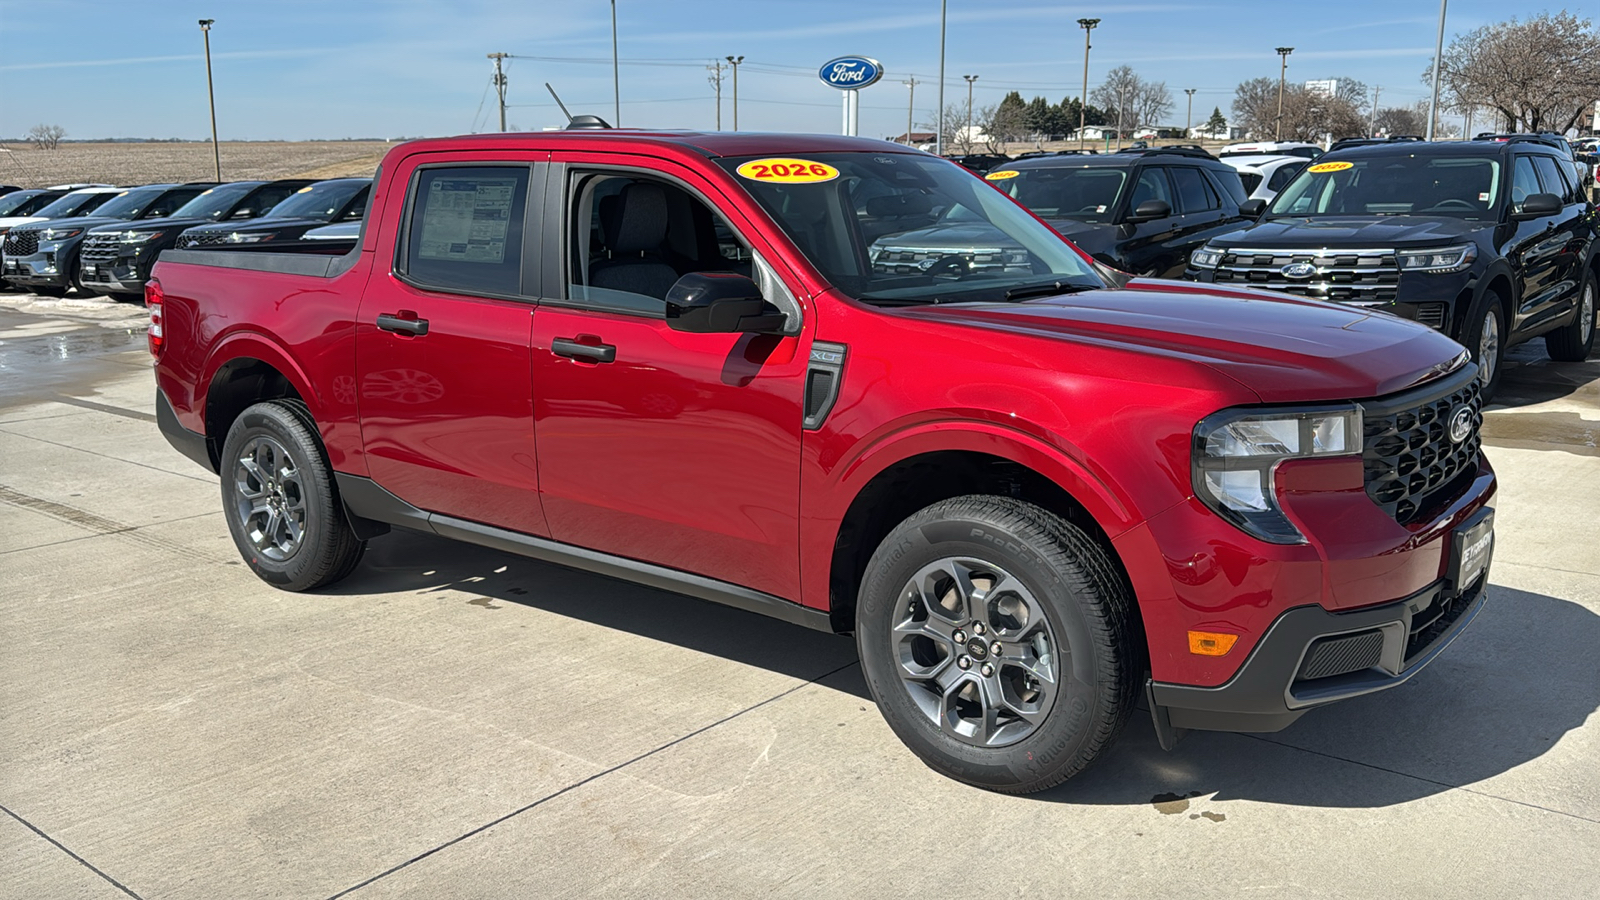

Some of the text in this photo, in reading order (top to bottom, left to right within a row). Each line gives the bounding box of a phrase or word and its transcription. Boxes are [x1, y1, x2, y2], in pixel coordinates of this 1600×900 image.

[829, 62, 866, 82] Ford
[751, 163, 829, 178] 2026
[1312, 163, 1348, 171] 2026
[810, 351, 840, 361] XLT
[1455, 412, 1471, 437] Ford
